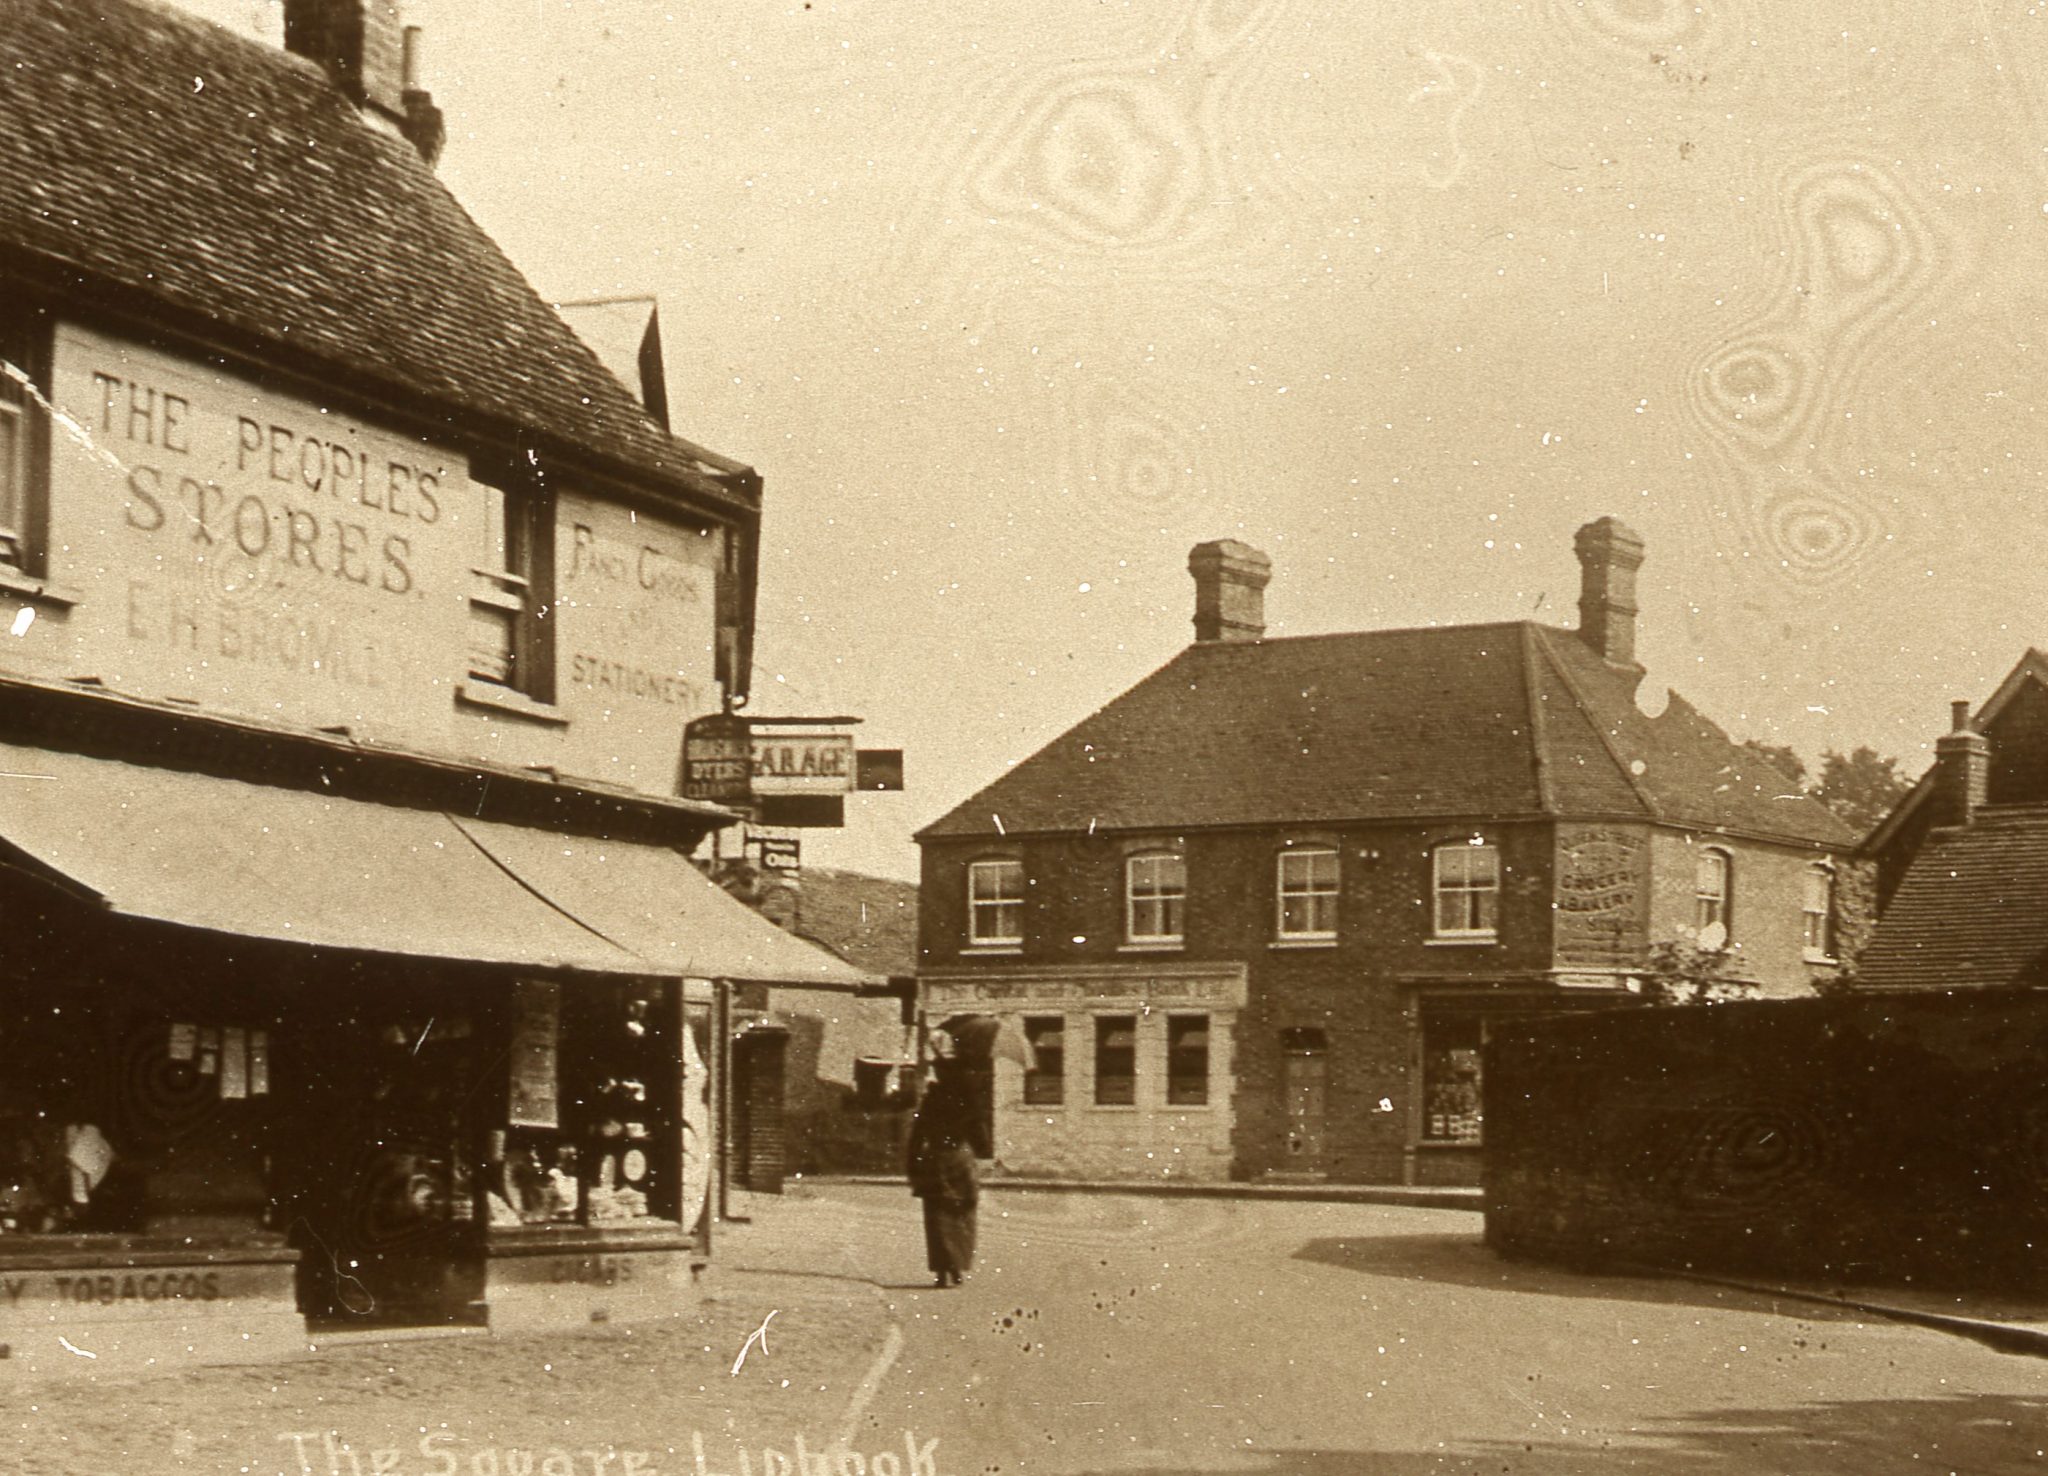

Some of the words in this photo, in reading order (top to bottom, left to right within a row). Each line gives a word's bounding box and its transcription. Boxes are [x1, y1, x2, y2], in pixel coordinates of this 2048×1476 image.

[93, 371, 189, 454] THE
[126, 465, 414, 595] STORES
[55, 1272, 220, 1305] TOBACCOS
